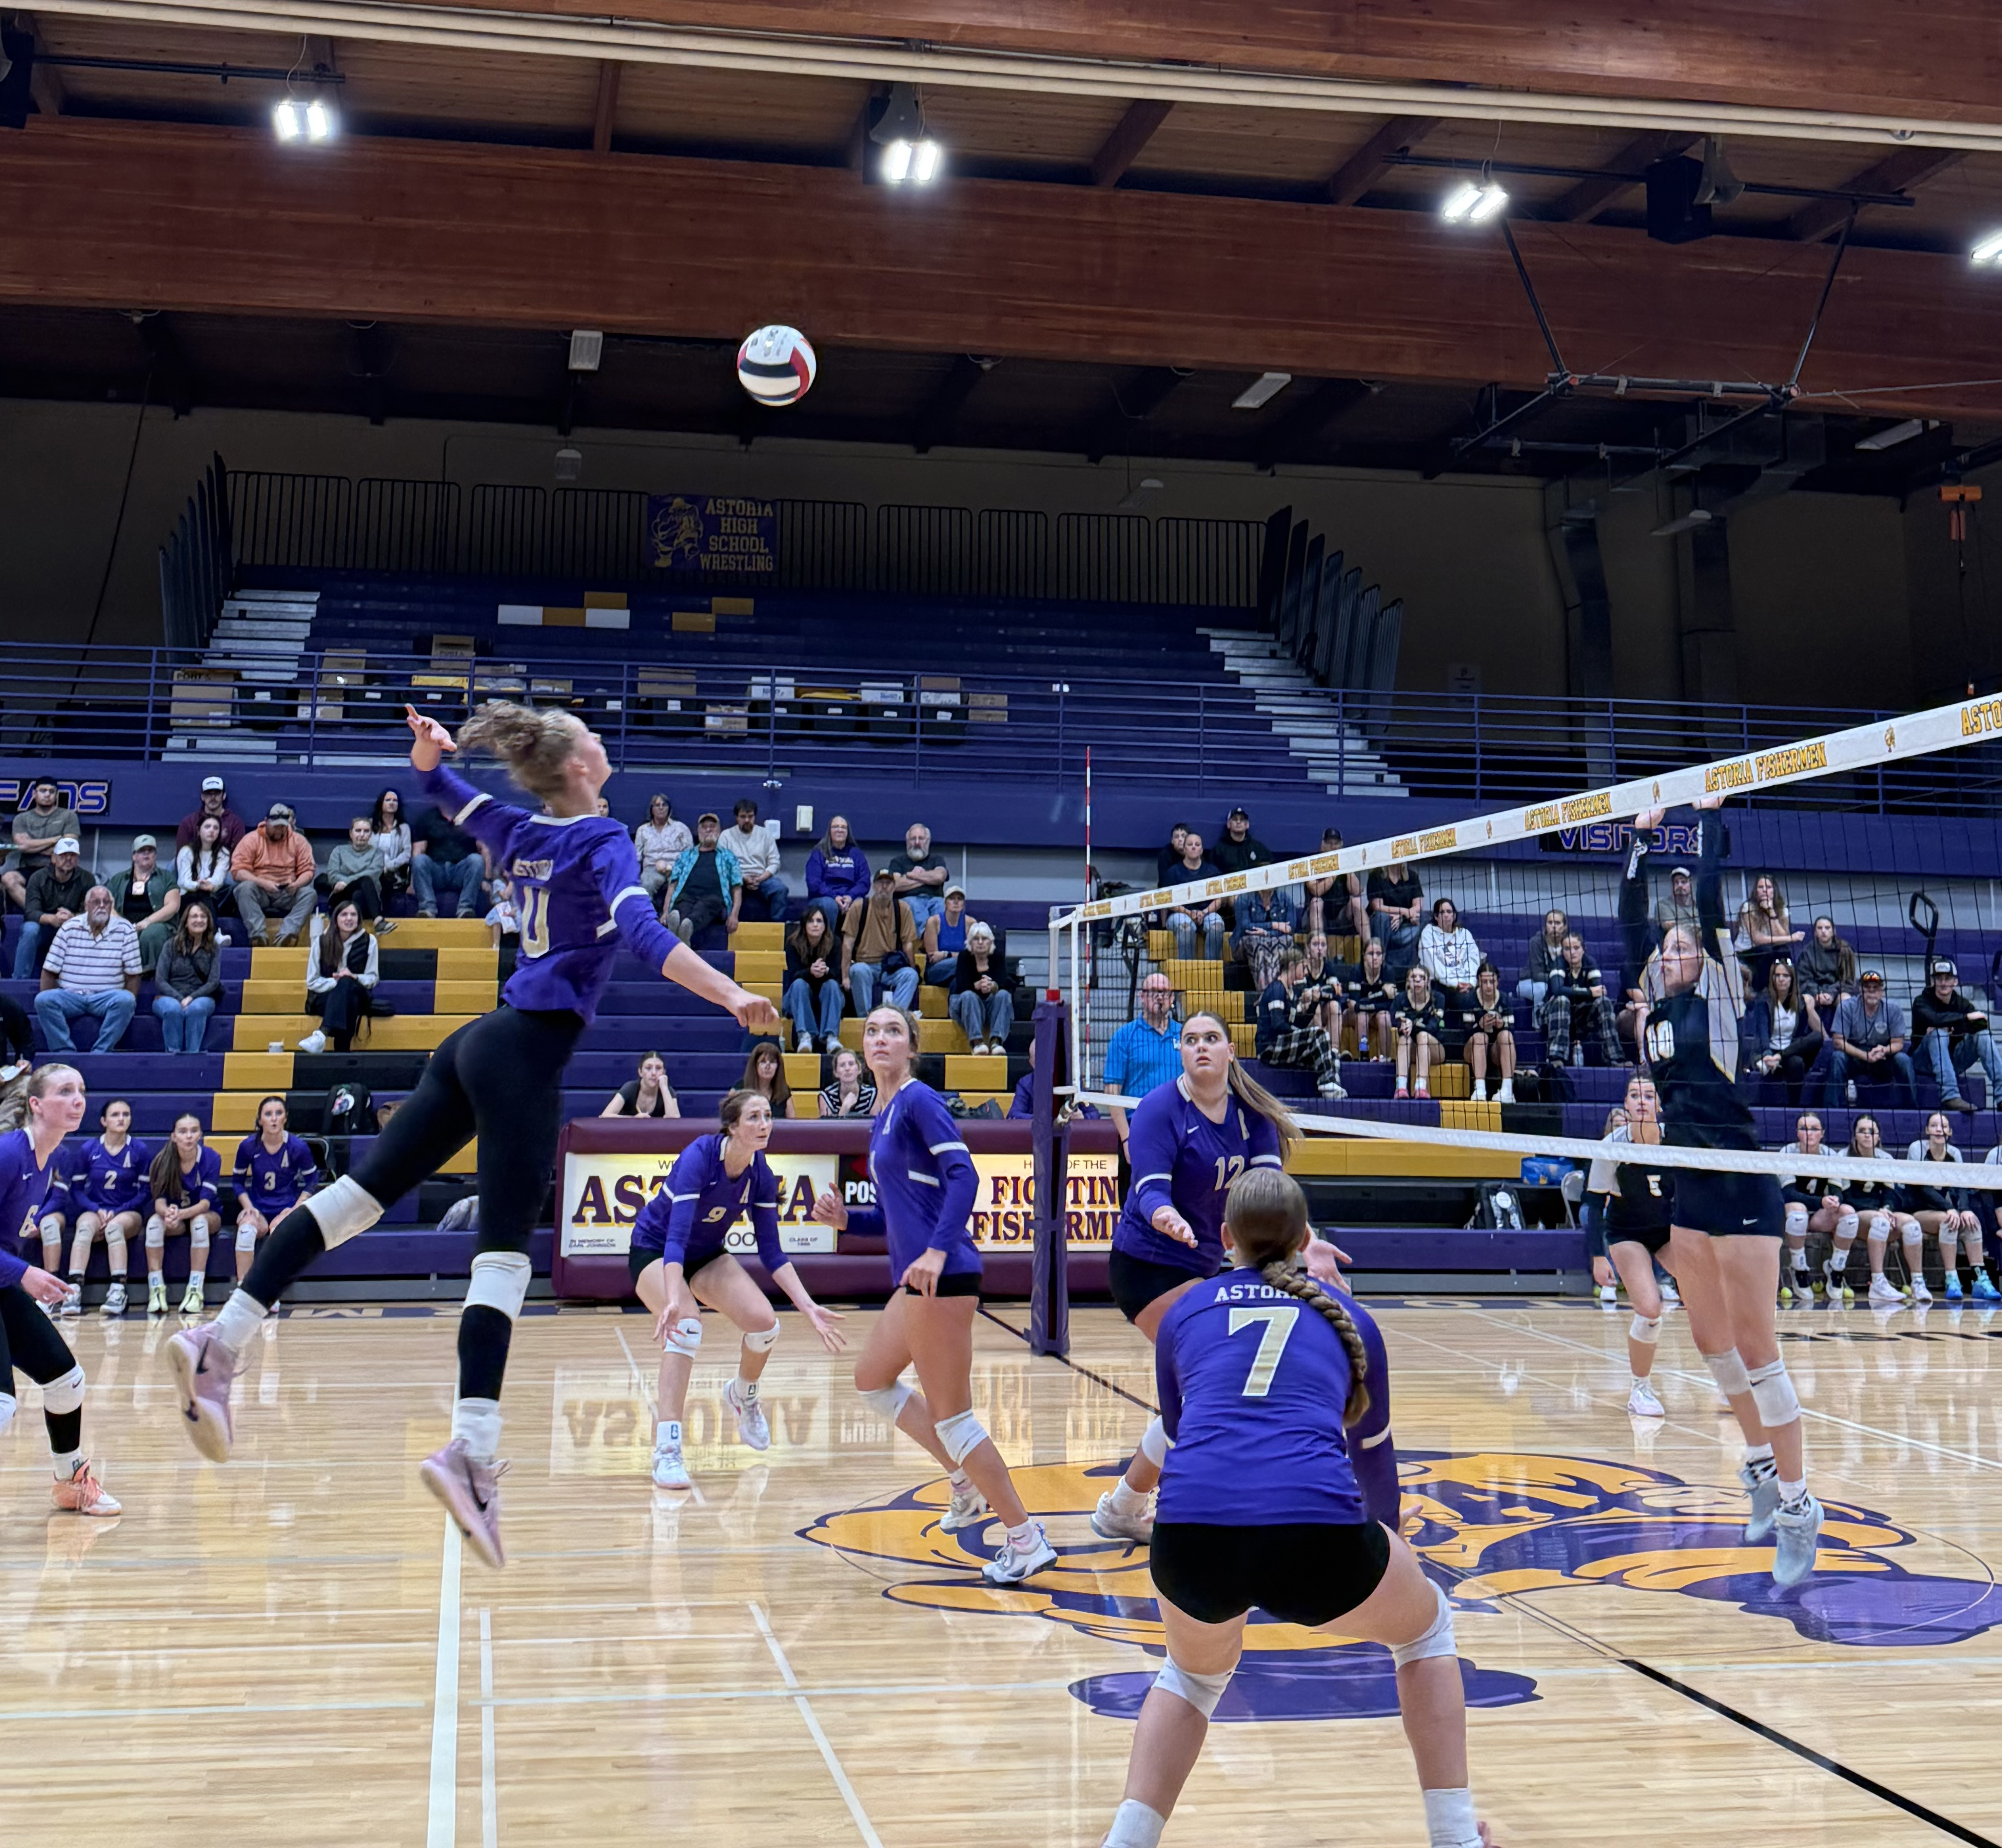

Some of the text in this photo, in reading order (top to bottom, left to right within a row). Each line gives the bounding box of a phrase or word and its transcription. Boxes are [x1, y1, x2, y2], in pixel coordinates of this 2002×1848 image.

[705, 498, 773, 517] ASTORIA
[720, 517, 758, 534] HIGH
[709, 535, 769, 553] SCHOOL
[700, 553, 774, 572] WRESTLING
[1705, 741, 1828, 793] ASTORIA FISHERMEN
[1083, 1160, 1107, 1169] THE
[1214, 1155, 1245, 1191] 12
[104, 1170, 118, 1190] 2
[264, 1171, 276, 1191] 3
[1646, 1174, 1662, 1197] 5
[702, 1206, 727, 1223] 9
[1228, 1306, 1299, 1397] 7
